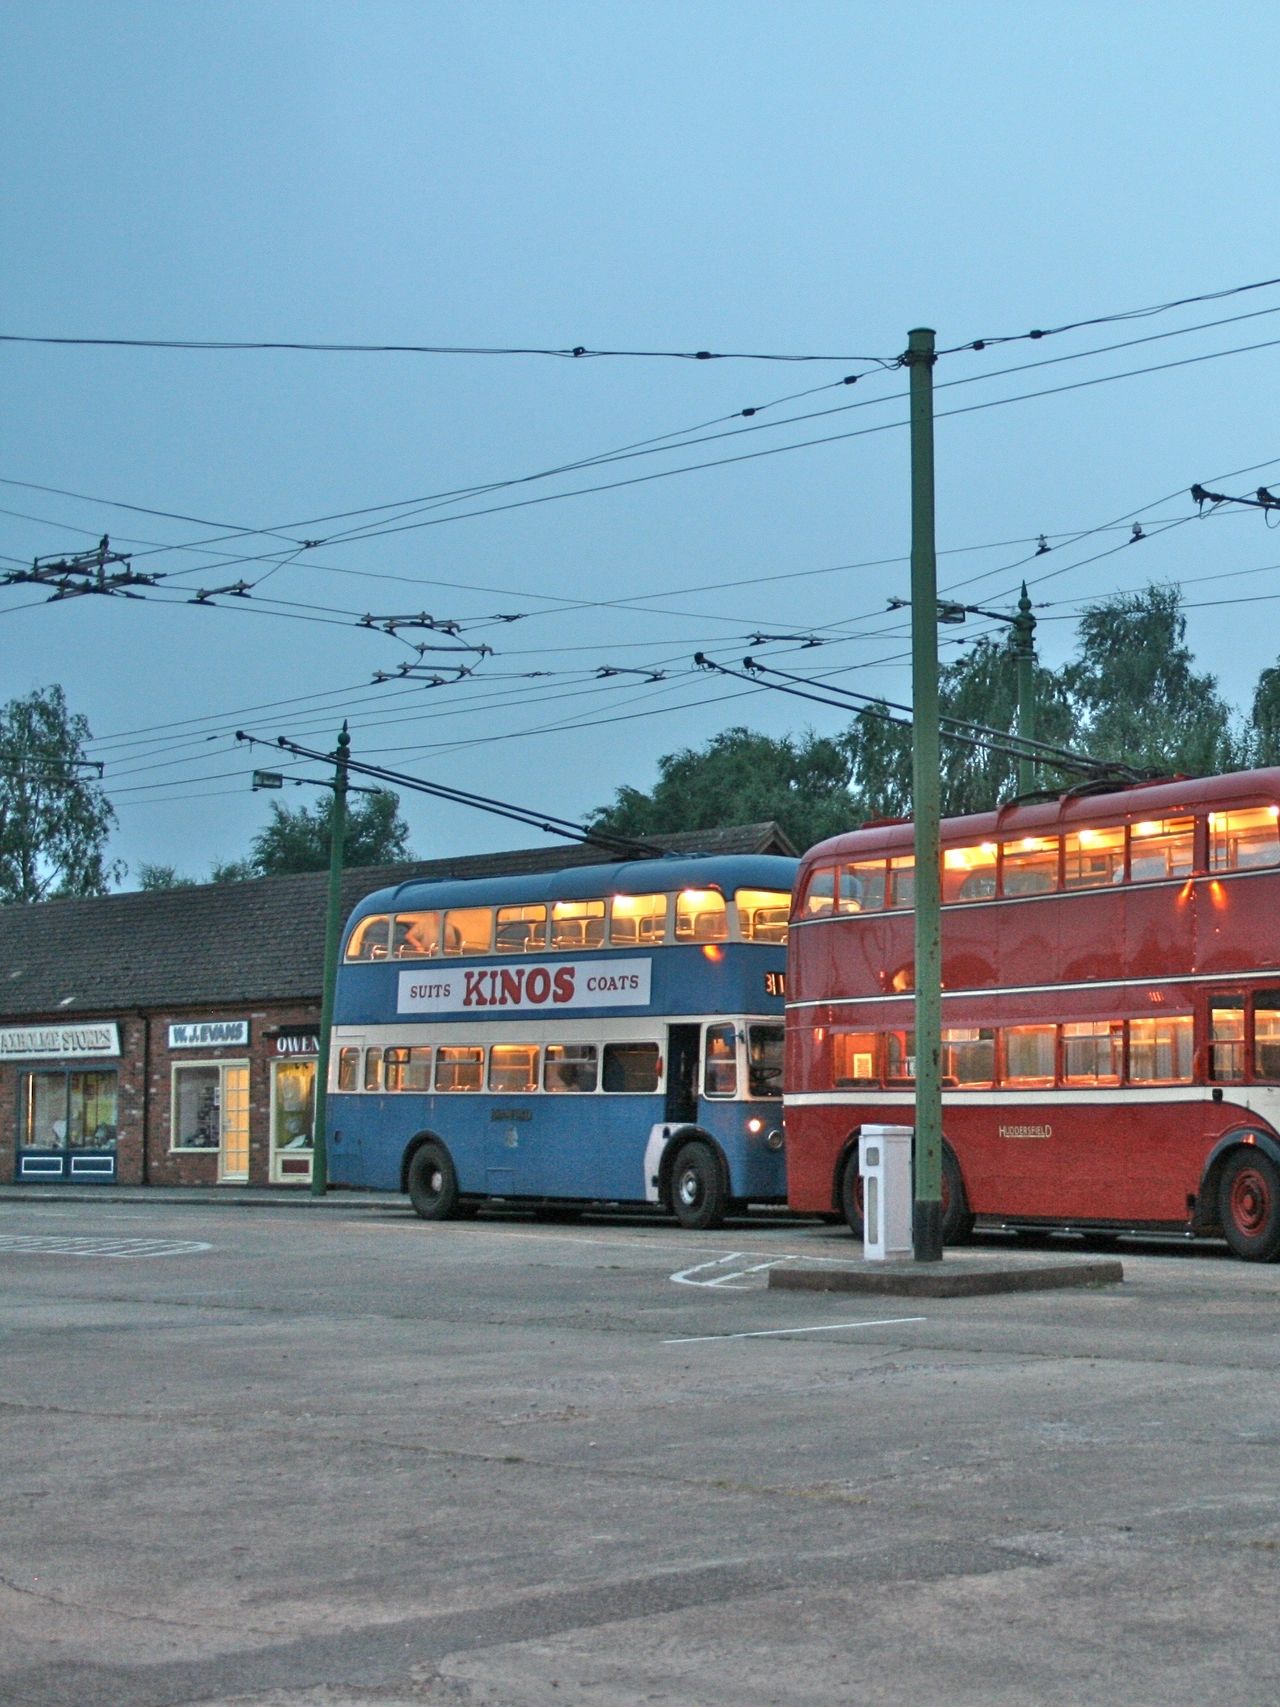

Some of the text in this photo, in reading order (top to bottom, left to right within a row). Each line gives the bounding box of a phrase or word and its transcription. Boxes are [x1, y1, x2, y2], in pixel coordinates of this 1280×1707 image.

[410, 967, 639, 1005] SUITS KINOS COATS
[998, 1124, 1053, 1138] HUDDERSFIELD
